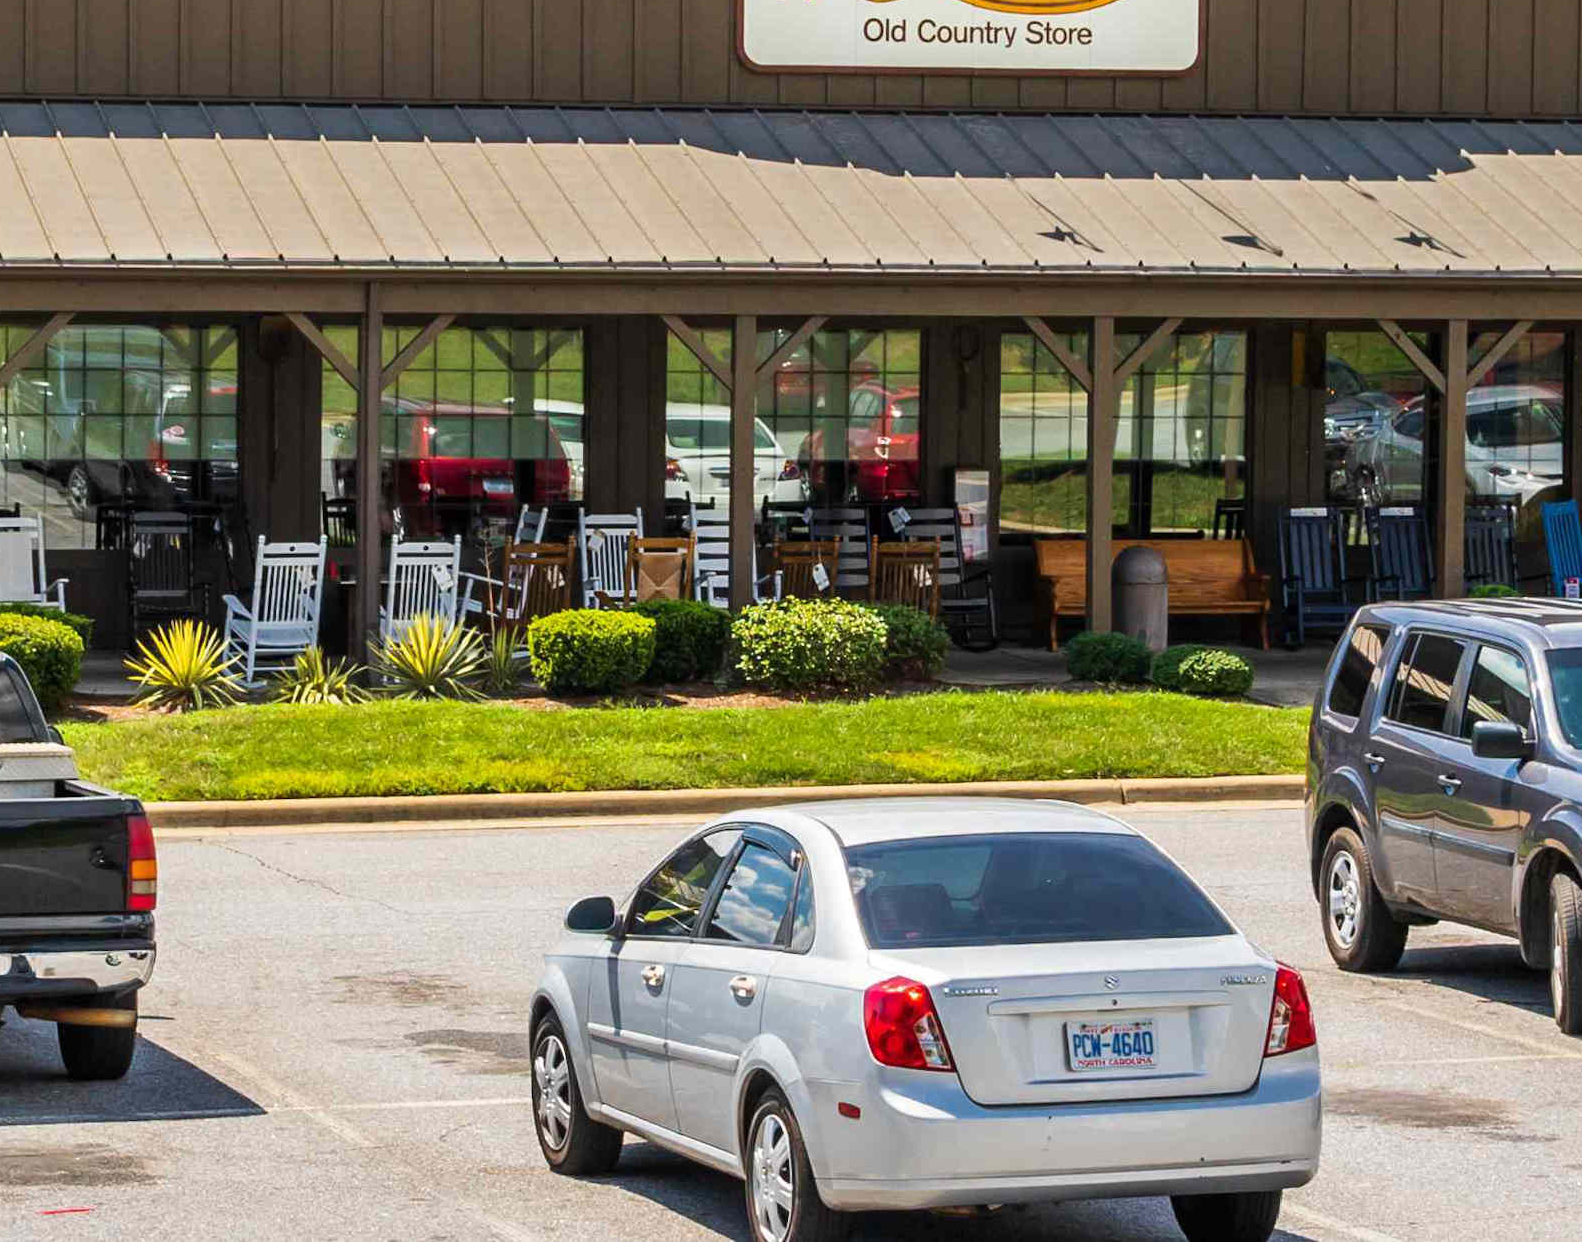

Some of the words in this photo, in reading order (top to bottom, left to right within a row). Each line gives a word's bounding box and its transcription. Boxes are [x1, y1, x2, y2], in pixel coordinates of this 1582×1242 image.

[863, 17, 906, 43] Old
[917, 19, 1017, 48] Country
[1025, 21, 1093, 45] Store
[1072, 1031, 1154, 1058] PCW-4640
[1109, 1056, 1153, 1066] CAROLINA
